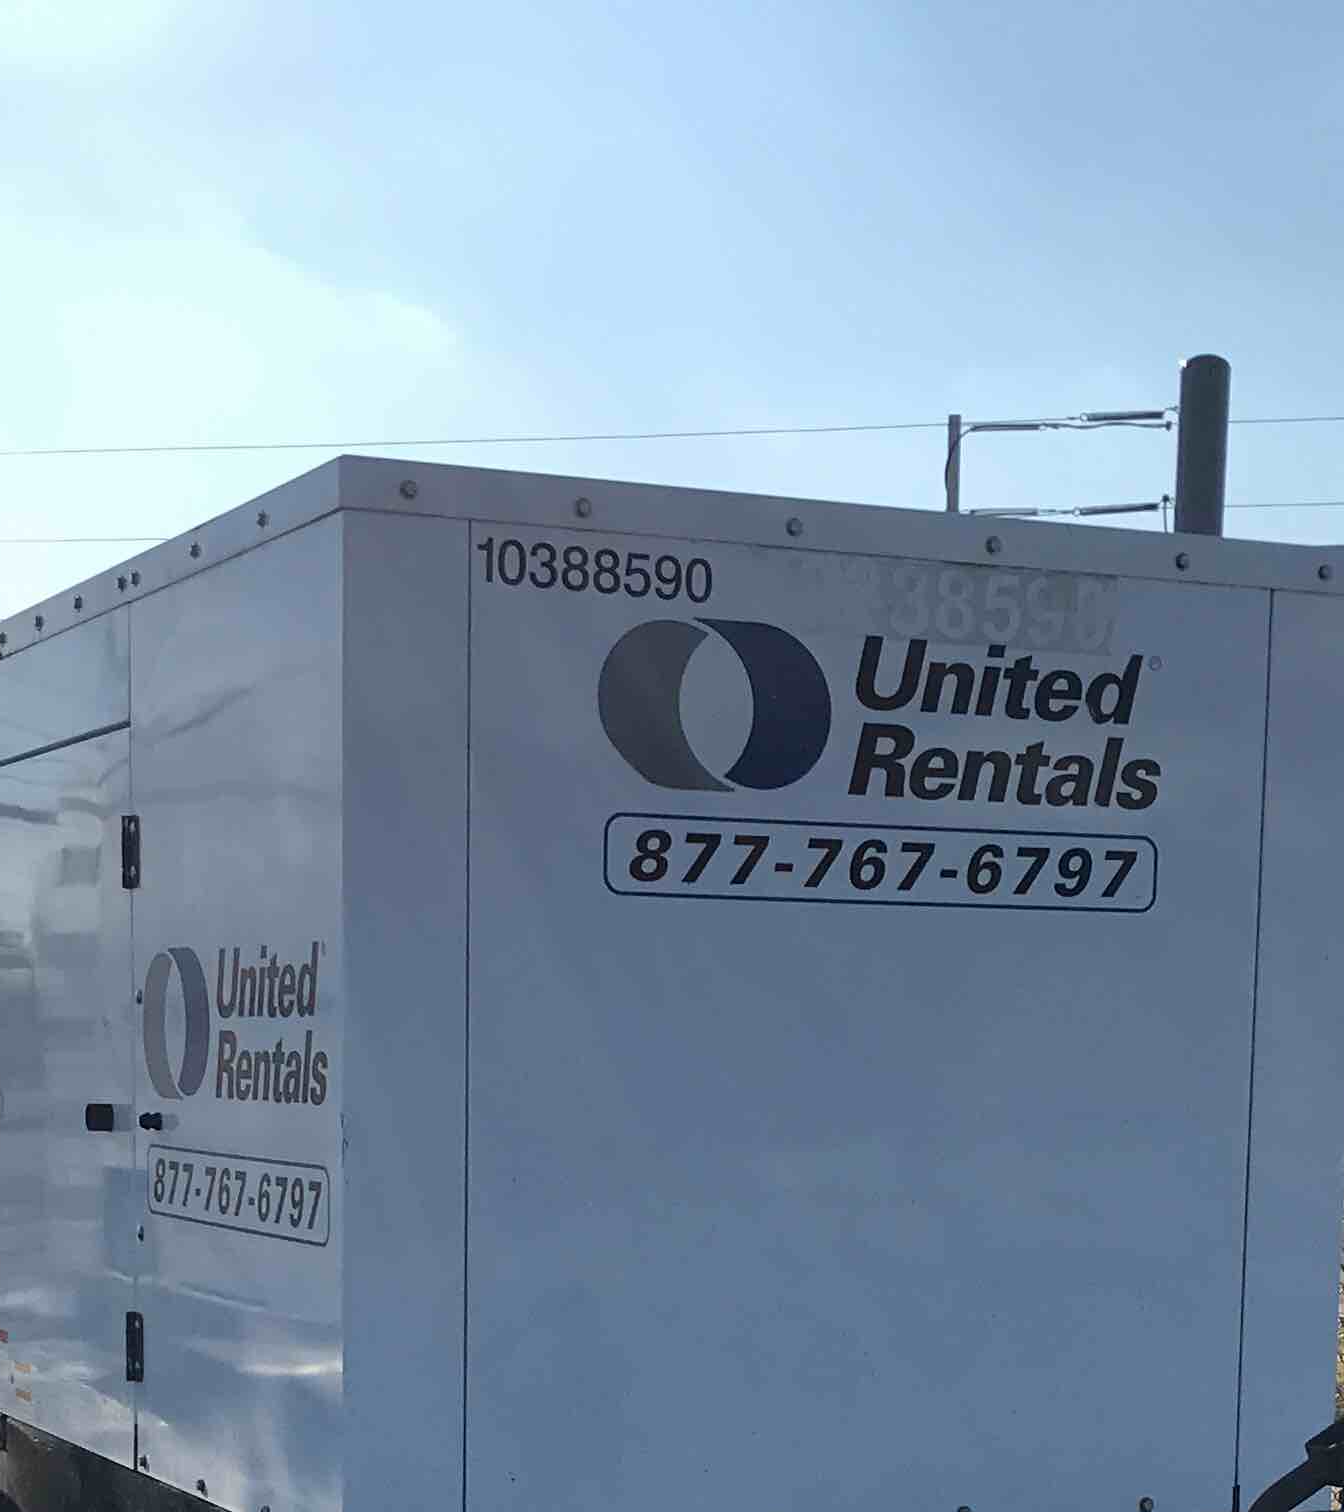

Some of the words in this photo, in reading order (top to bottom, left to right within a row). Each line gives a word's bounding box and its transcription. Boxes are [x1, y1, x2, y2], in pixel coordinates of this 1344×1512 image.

[477, 536, 713, 603] 10388590
[854, 635, 1144, 725] United
[847, 722, 1162, 810] Rentals
[627, 829, 1138, 899] 877-767-6797
[215, 940, 320, 1019] United
[215, 1029, 329, 1106] Rentals
[153, 1158, 322, 1230] 877-767-6797
